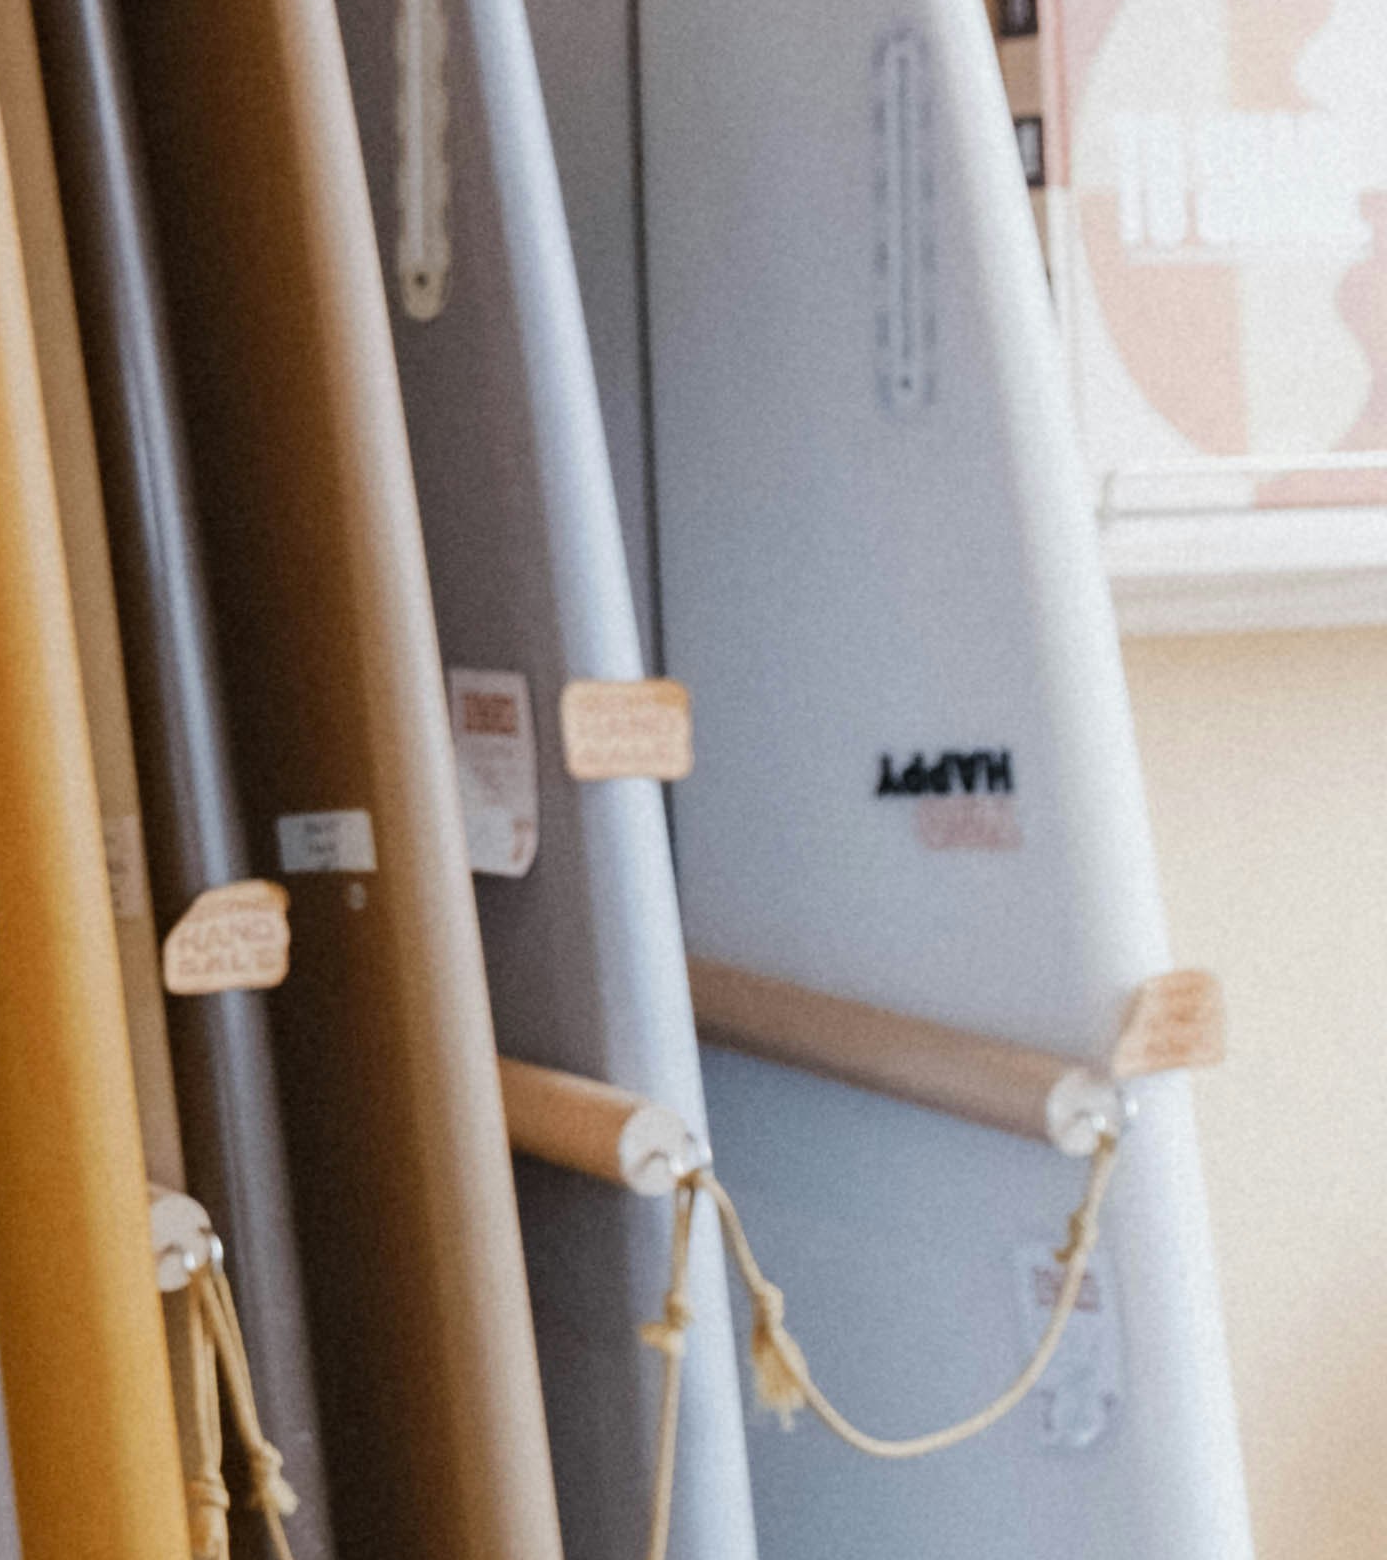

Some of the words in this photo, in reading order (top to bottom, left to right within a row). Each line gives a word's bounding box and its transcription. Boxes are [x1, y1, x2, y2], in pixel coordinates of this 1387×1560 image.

[876, 748, 1015, 796] HAPPY
[177, 917, 277, 953] HAND
[177, 946, 277, 976] SALE
